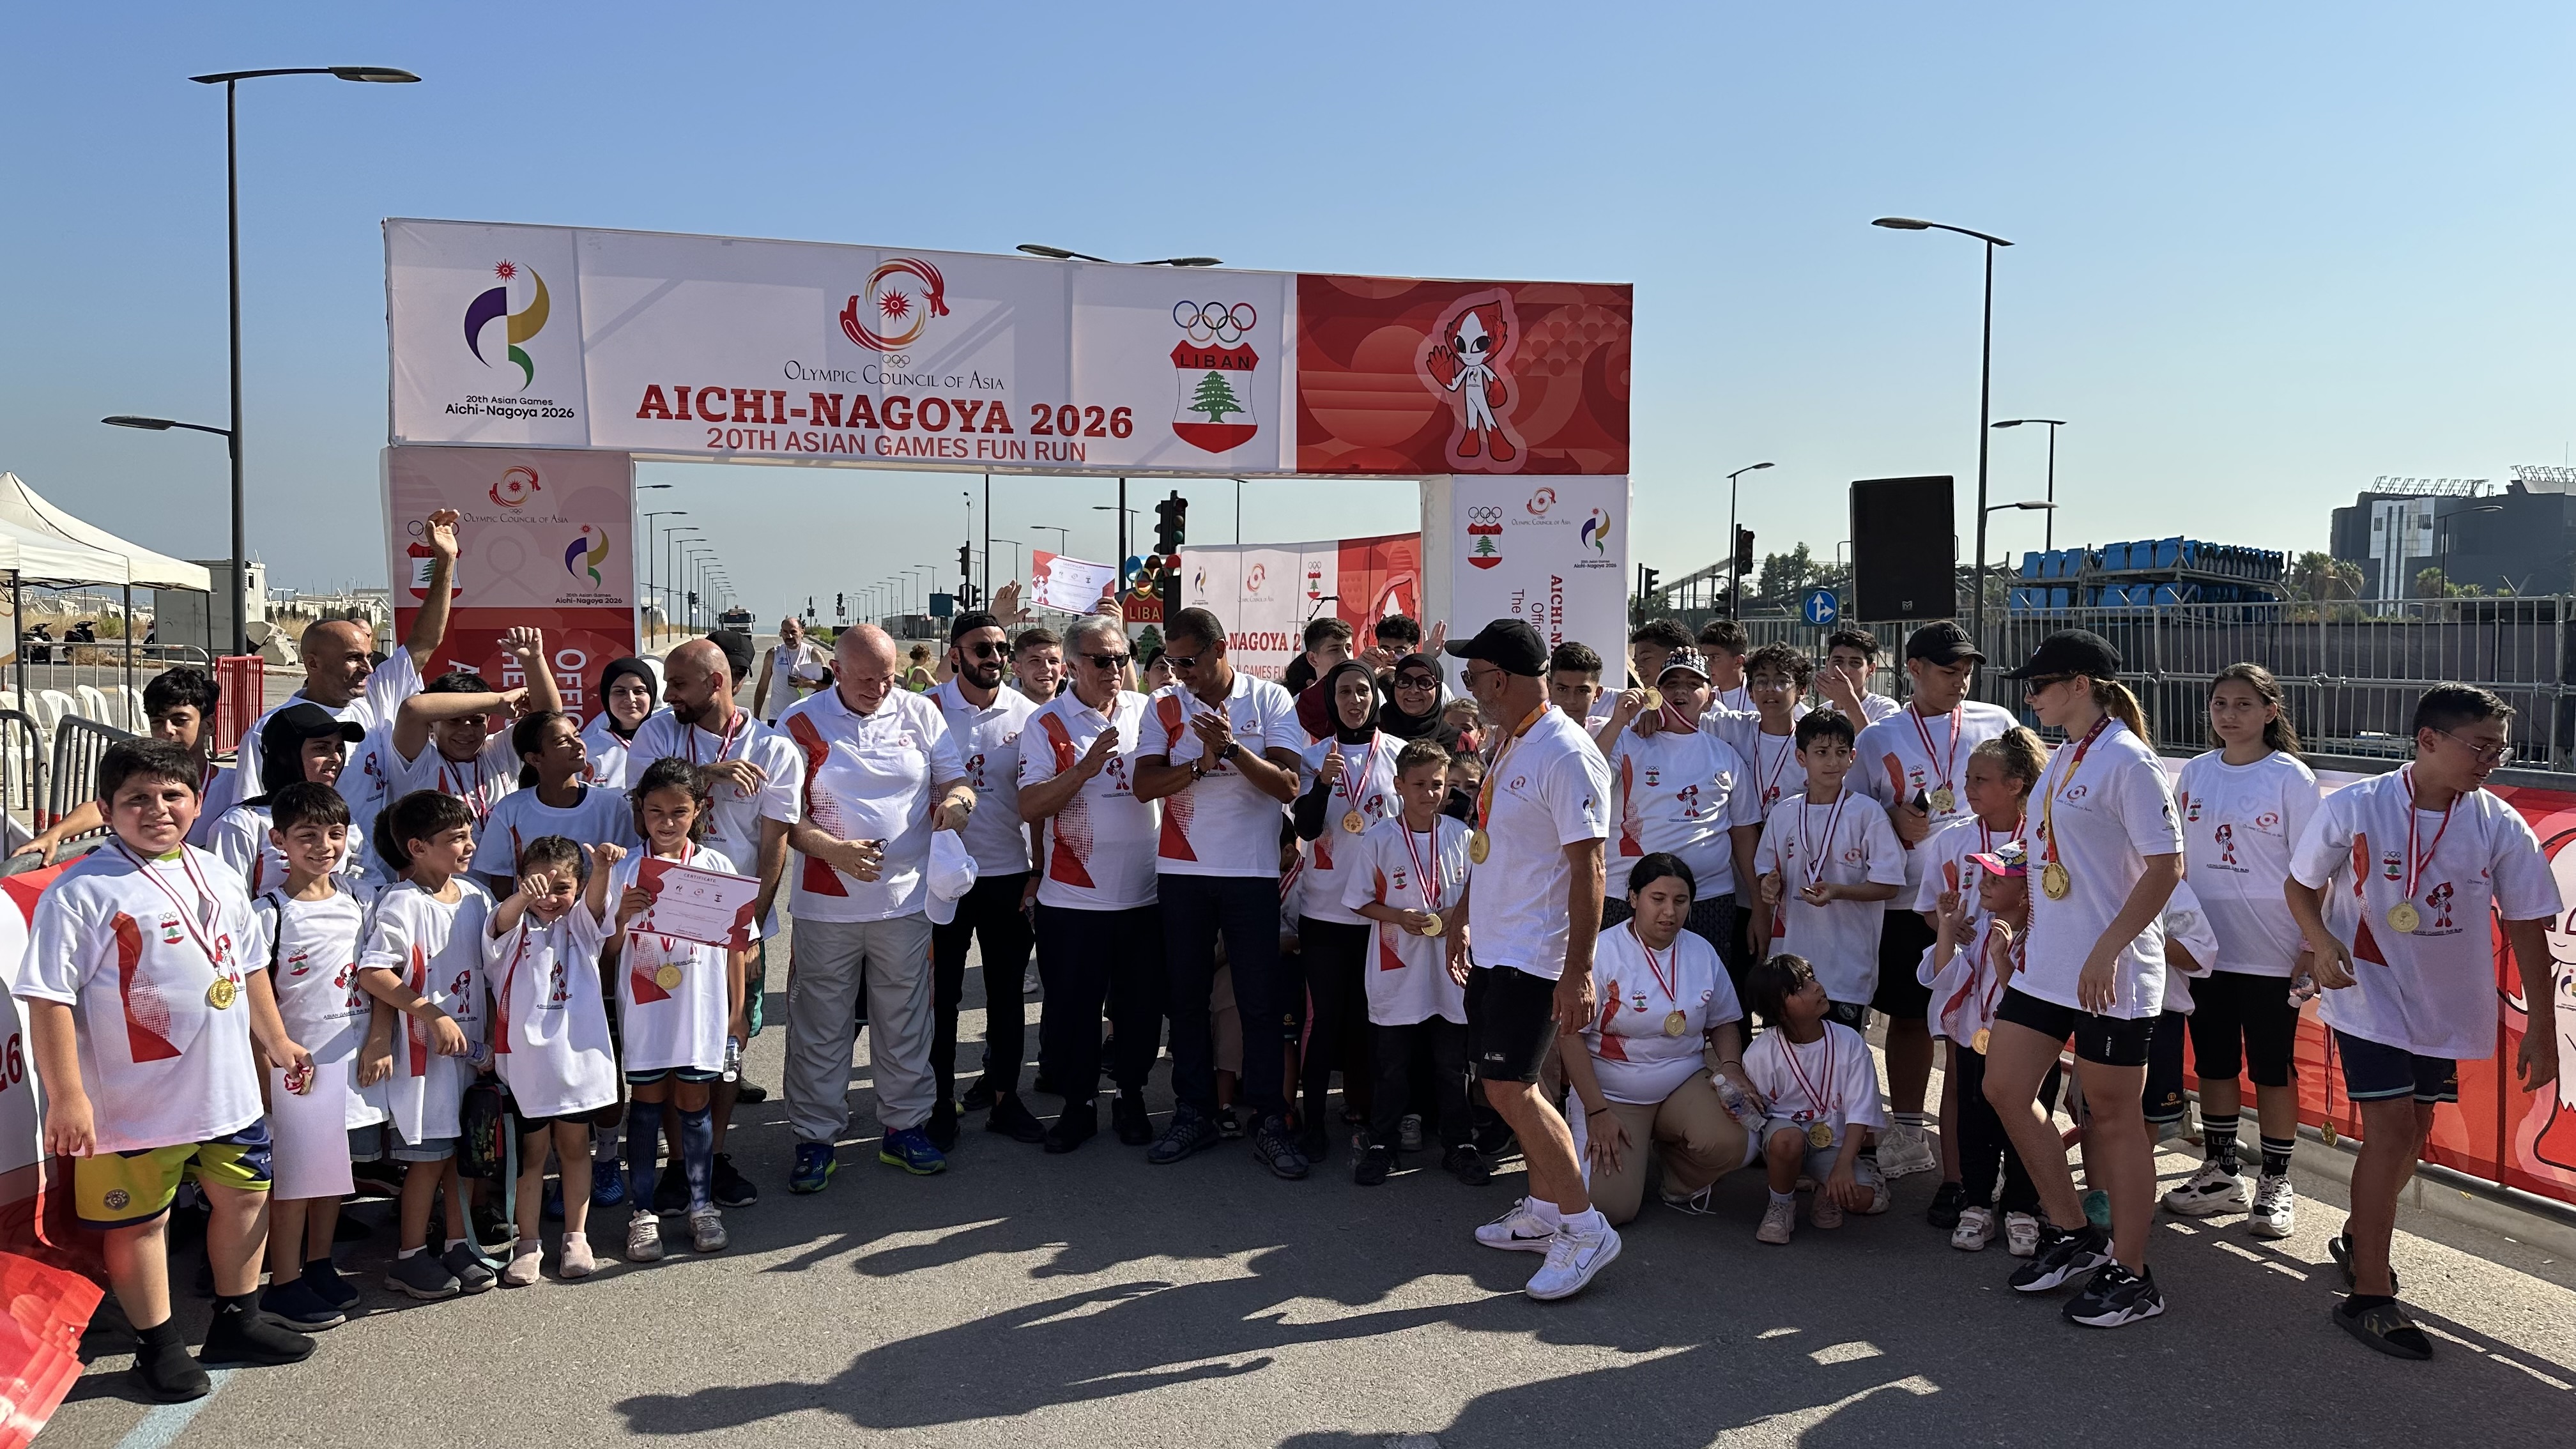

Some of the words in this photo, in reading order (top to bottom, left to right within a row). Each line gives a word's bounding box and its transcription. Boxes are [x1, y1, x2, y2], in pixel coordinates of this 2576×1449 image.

[1179, 352, 1250, 370] LIBAN
[784, 360, 857, 383] OLYMPIC
[862, 364, 939, 387] COUNCIL
[944, 375, 963, 388] OF
[969, 369, 1004, 390] ASIA
[466, 395, 488, 403] 20th
[491, 395, 517, 404] Asian
[519, 397, 553, 406] Games
[445, 402, 537, 420] Aichi-Nagoya
[541, 407, 575, 418] 2026
[636, 384, 1015, 434] AICHI-NAGOYA
[1030, 403, 1133, 439] 2026
[707, 427, 776, 451] 20TH
[784, 431, 866, 456] ASIAN
[874, 435, 969, 459] GAMES
[977, 438, 1025, 461] FUN
[1034, 441, 1085, 463] RUN
[463, 512, 498, 523] OLYMPIC
[500, 513, 537, 523] COUNCIL
[550, 514, 569, 523] ASIA
[1511, 588, 1524, 614] The
[684, 873, 716, 883] CERTIFICATE
